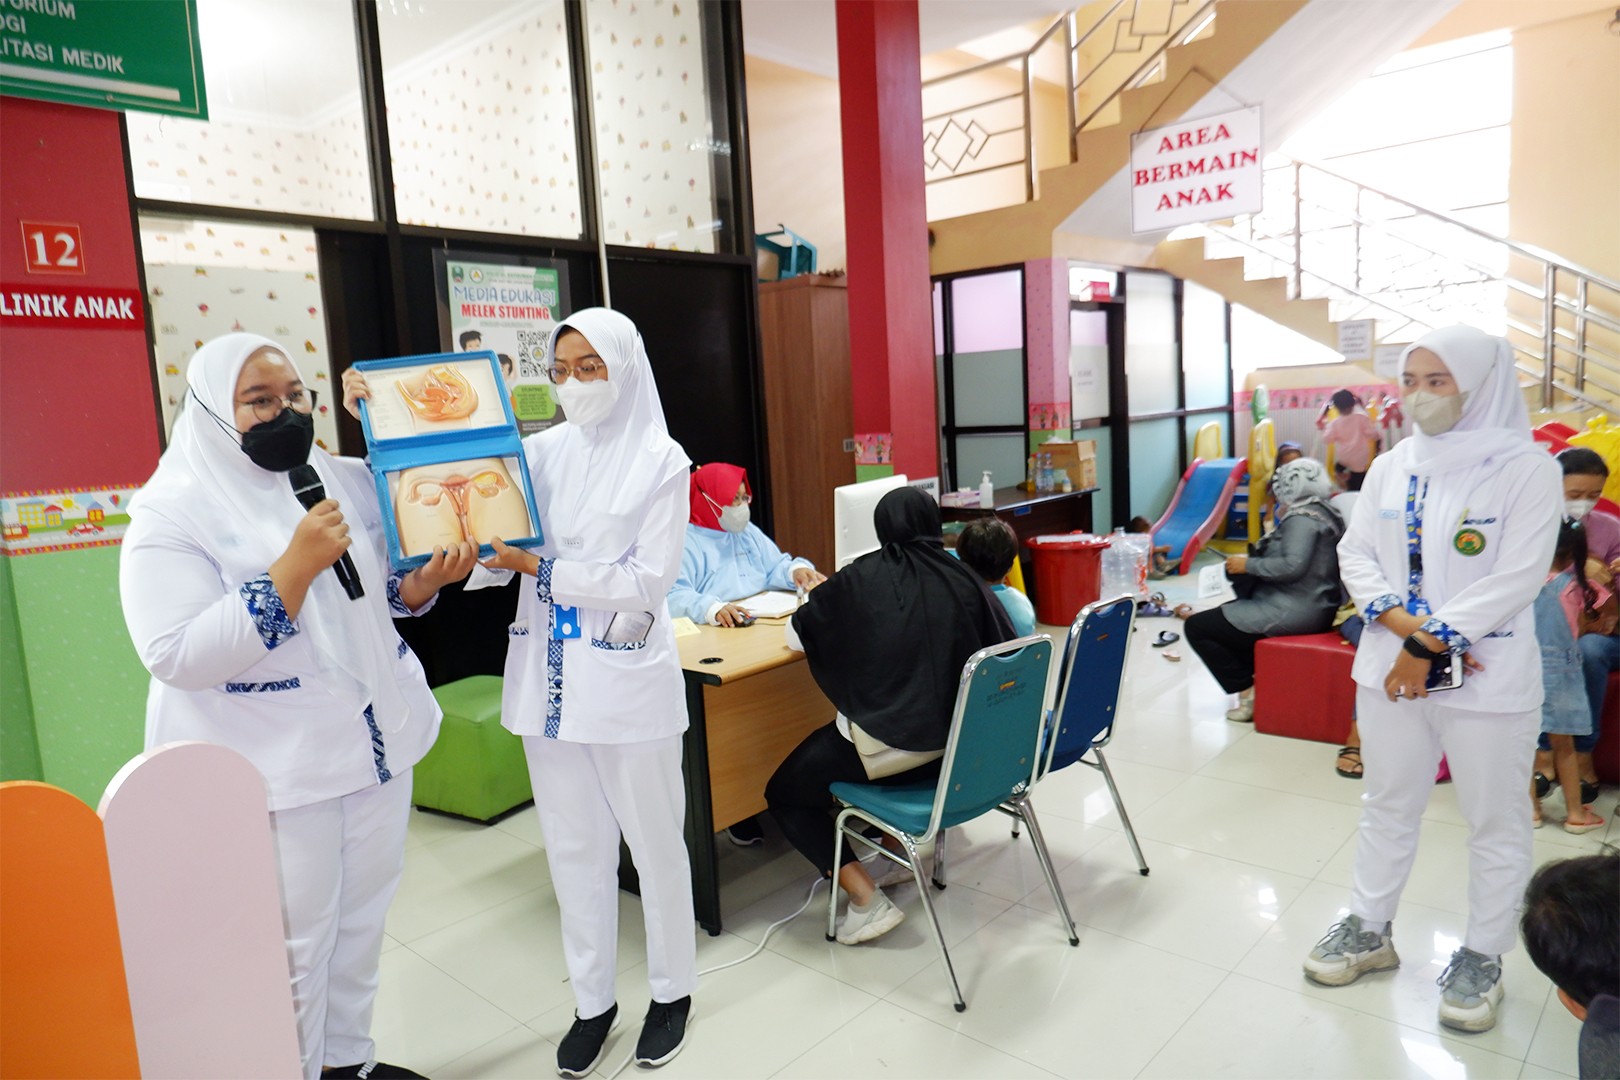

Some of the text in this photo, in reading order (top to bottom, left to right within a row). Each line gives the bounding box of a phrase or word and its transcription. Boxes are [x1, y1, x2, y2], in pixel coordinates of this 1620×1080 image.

[0, 37, 125, 74] ITASI MEDIK
[1156, 123, 1232, 155] AREA
[1133, 148, 1259, 188] BERMAIN
[1156, 182, 1235, 211] ANAK
[30, 231, 78, 267] 12
[74, 295, 135, 320] ANAK
[453, 285, 556, 306] MEDIA EDUKASI
[461, 304, 550, 320] MELEK STUNTING
